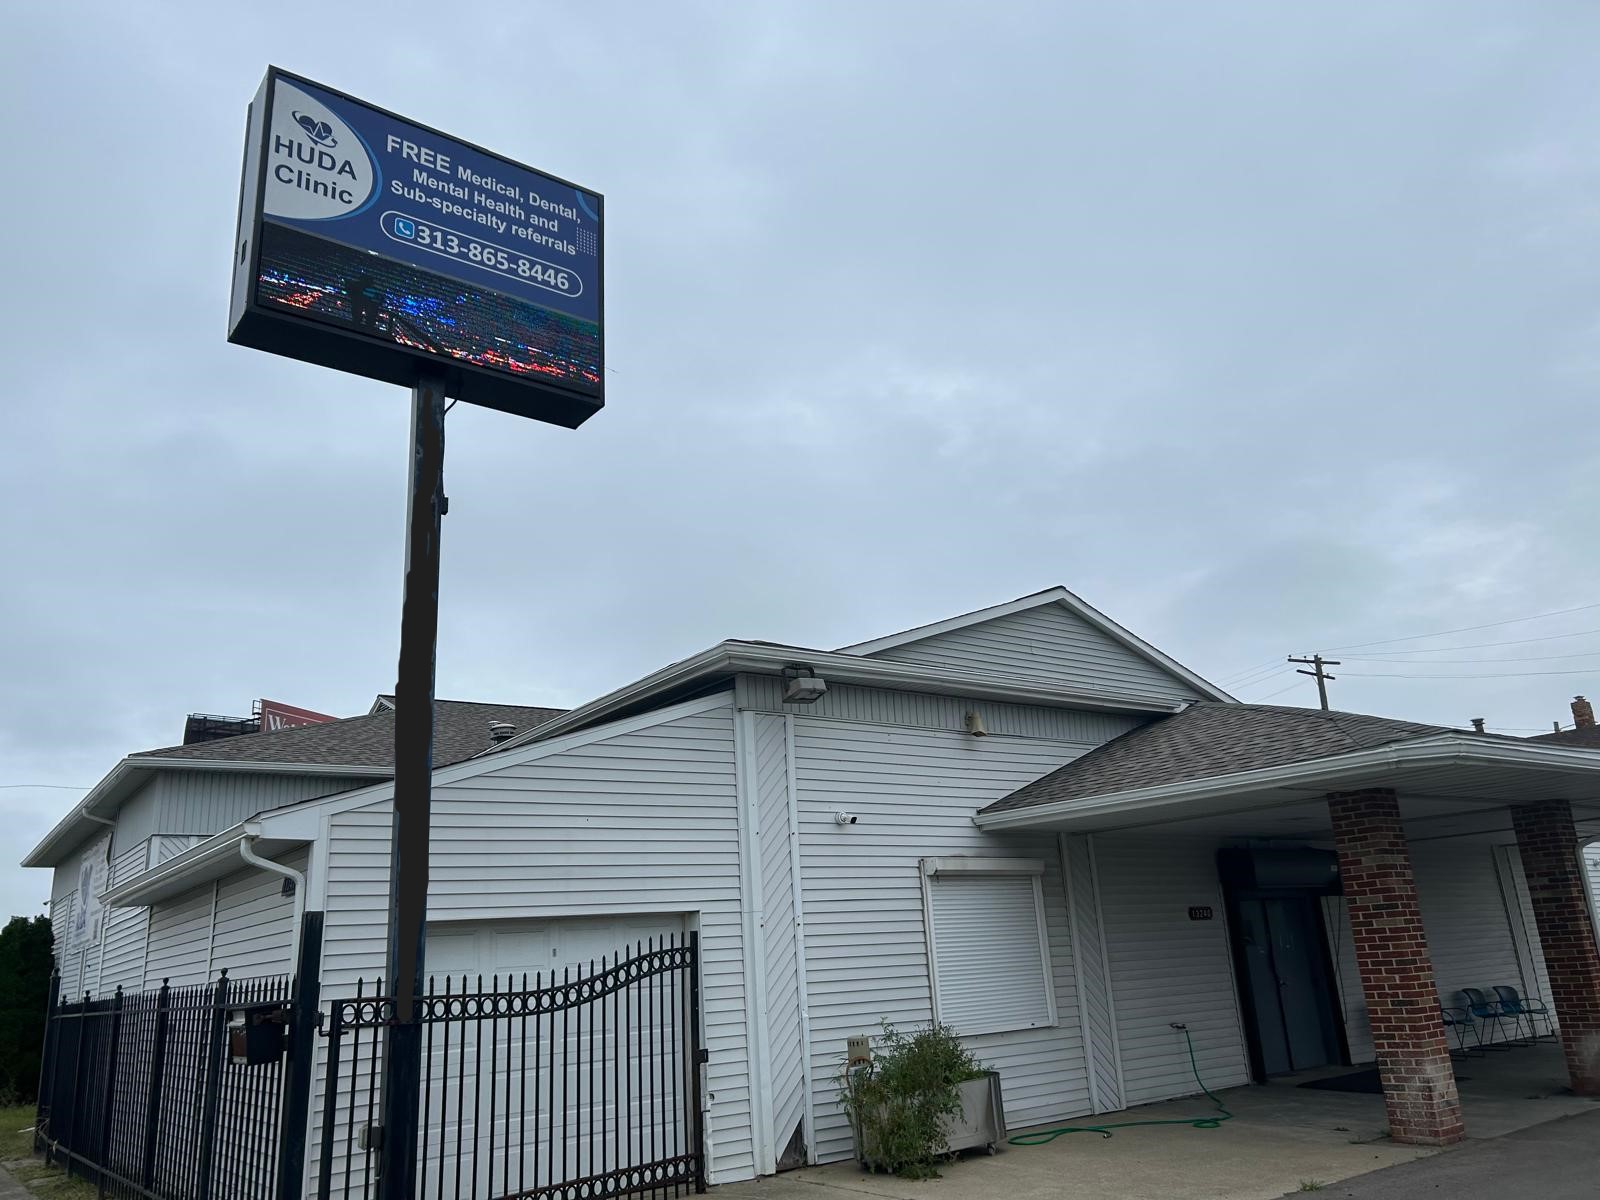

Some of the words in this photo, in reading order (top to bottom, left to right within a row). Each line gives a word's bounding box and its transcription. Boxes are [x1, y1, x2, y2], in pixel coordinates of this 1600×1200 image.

[274, 134, 357, 181] HUDA
[274, 164, 353, 205] Clinic
[386, 134, 450, 174] FREE
[457, 165, 524, 202] Medical,
[529, 191, 581, 224] Dental,
[390, 179, 508, 233] Sub-specialty
[511, 224, 576, 256] referrals
[413, 168, 468, 201] Mental
[474, 190, 525, 221] Health
[529, 213, 558, 232] and
[416, 225, 570, 290] 313-865-8446
